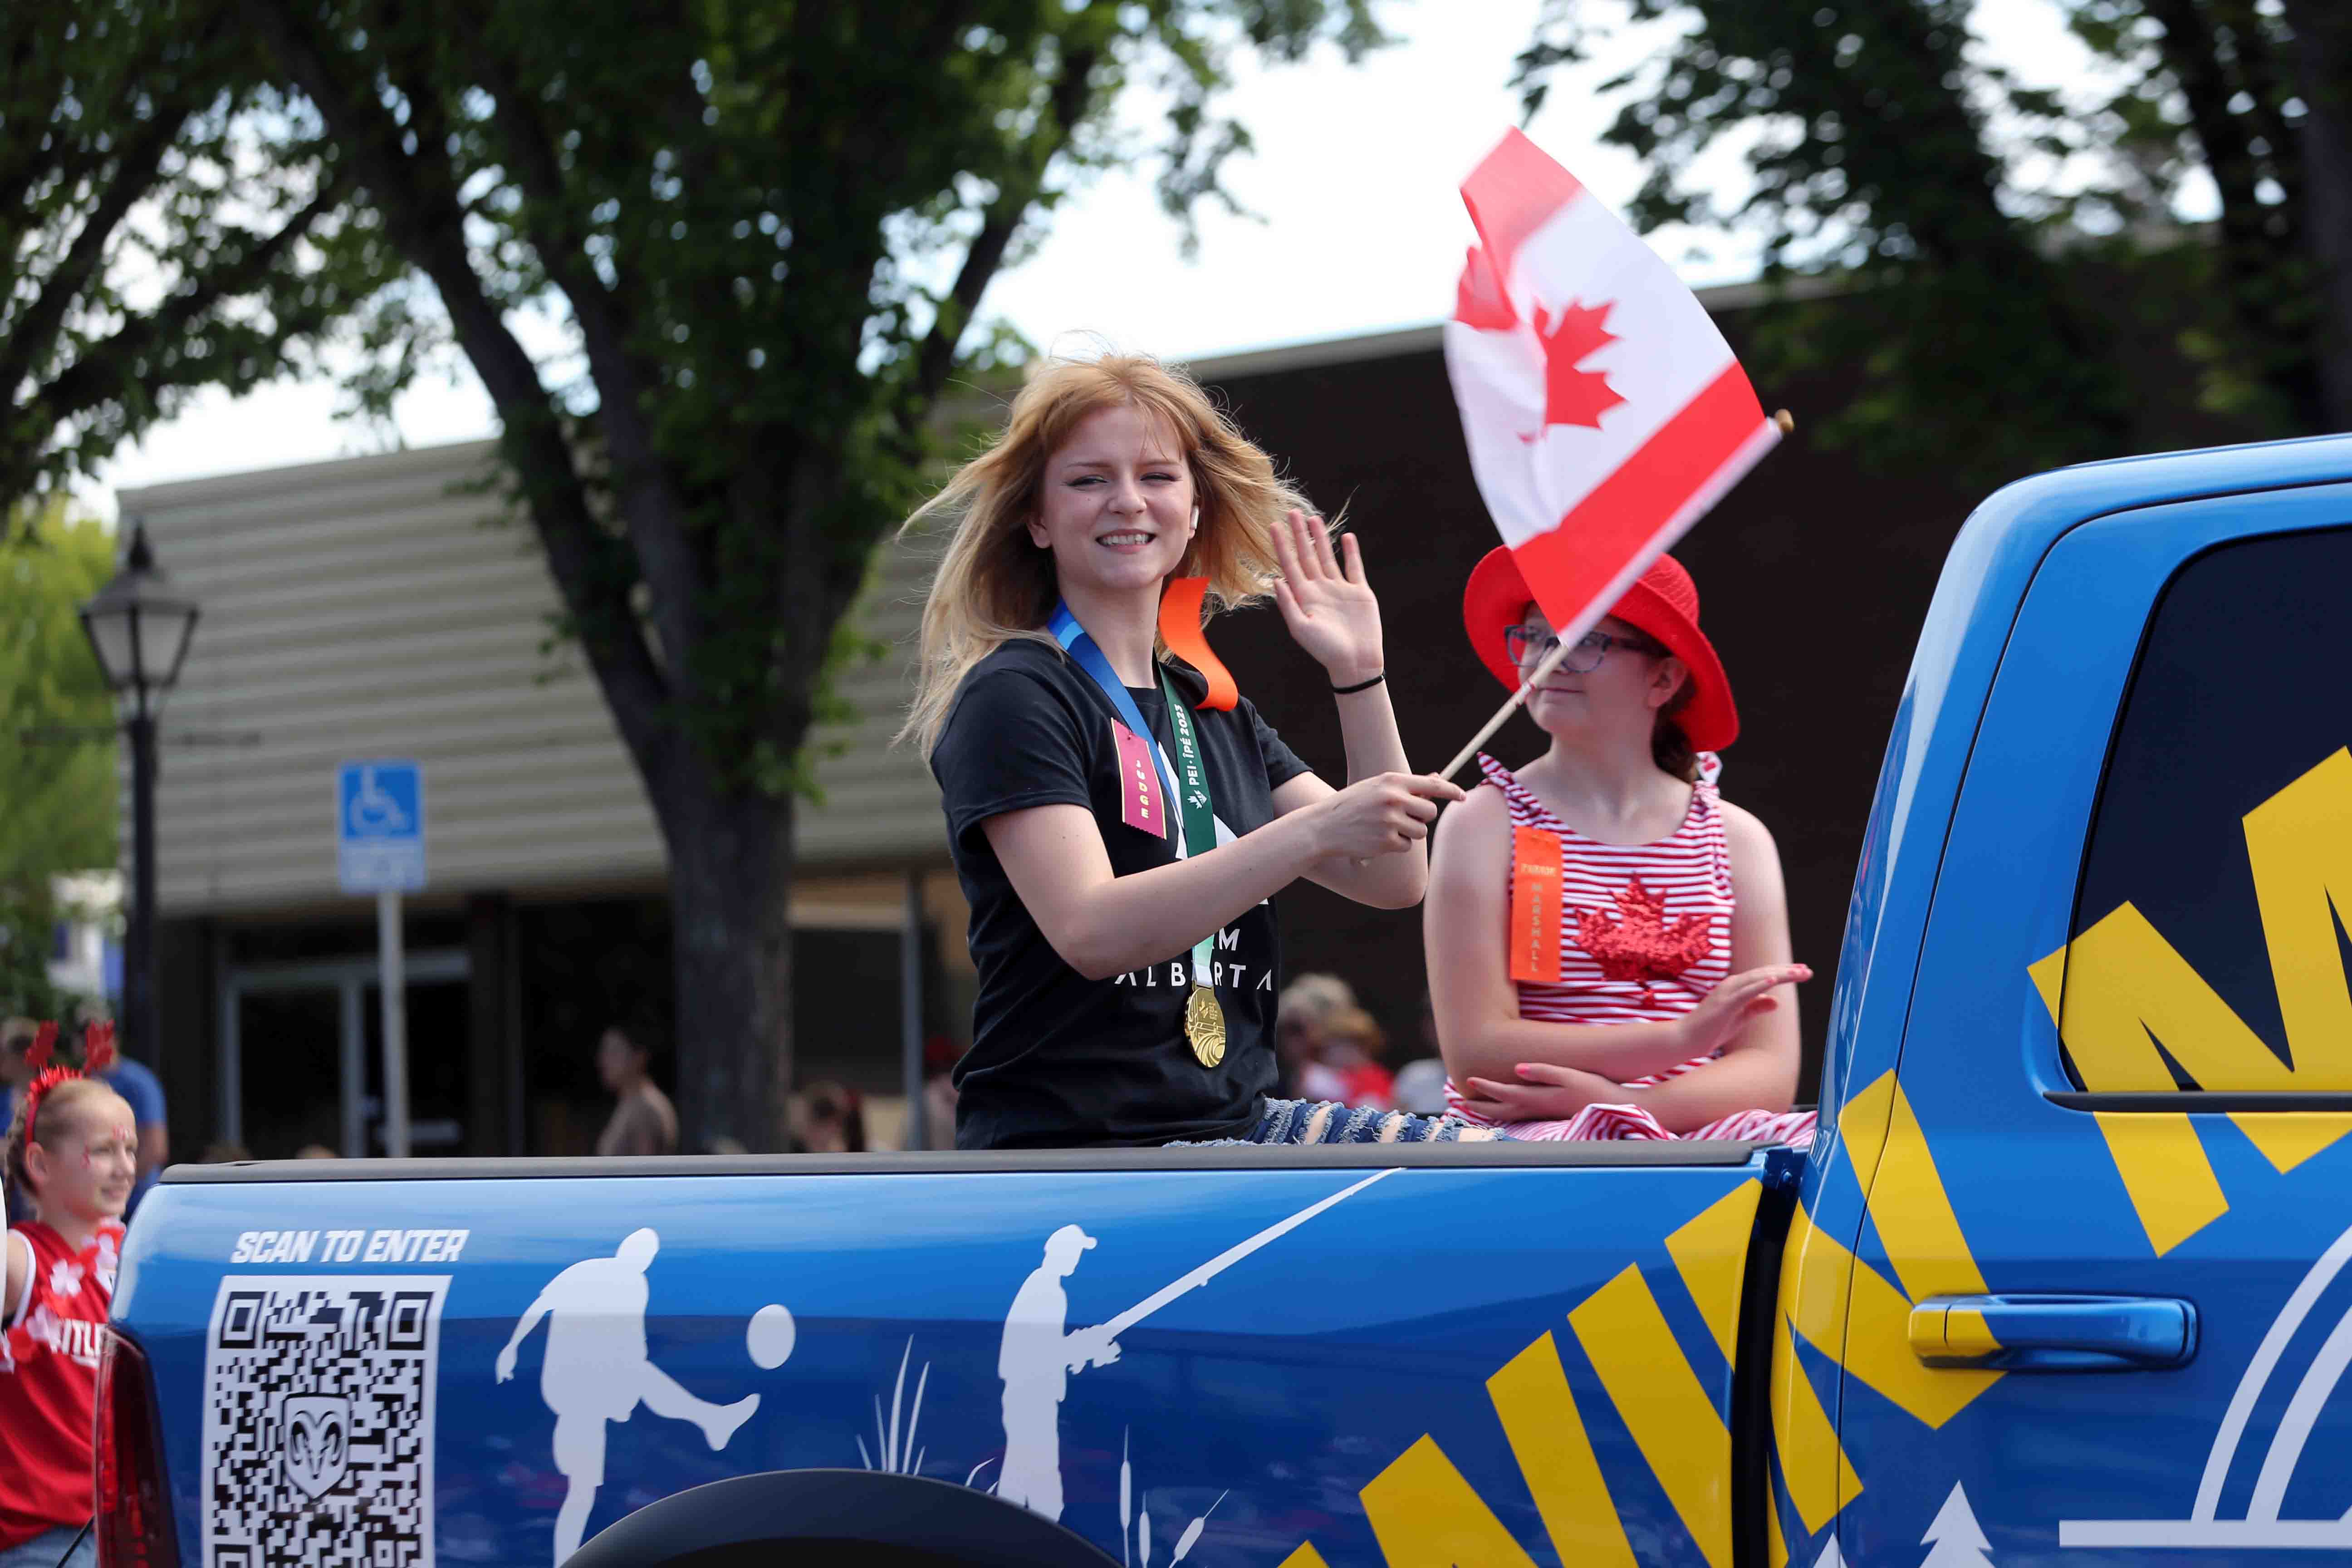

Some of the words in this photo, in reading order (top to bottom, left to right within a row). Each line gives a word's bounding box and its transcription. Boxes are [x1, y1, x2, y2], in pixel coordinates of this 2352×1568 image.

[1174, 704, 1190, 736] 2023
[1136, 759, 1150, 819] JUDGE
[1186, 765, 1200, 786] PEI
[1114, 961, 1271, 991] ALBRTA
[230, 1230, 320, 1263] SCAN
[319, 1230, 366, 1263] TO
[361, 1229, 470, 1262] ENTER
